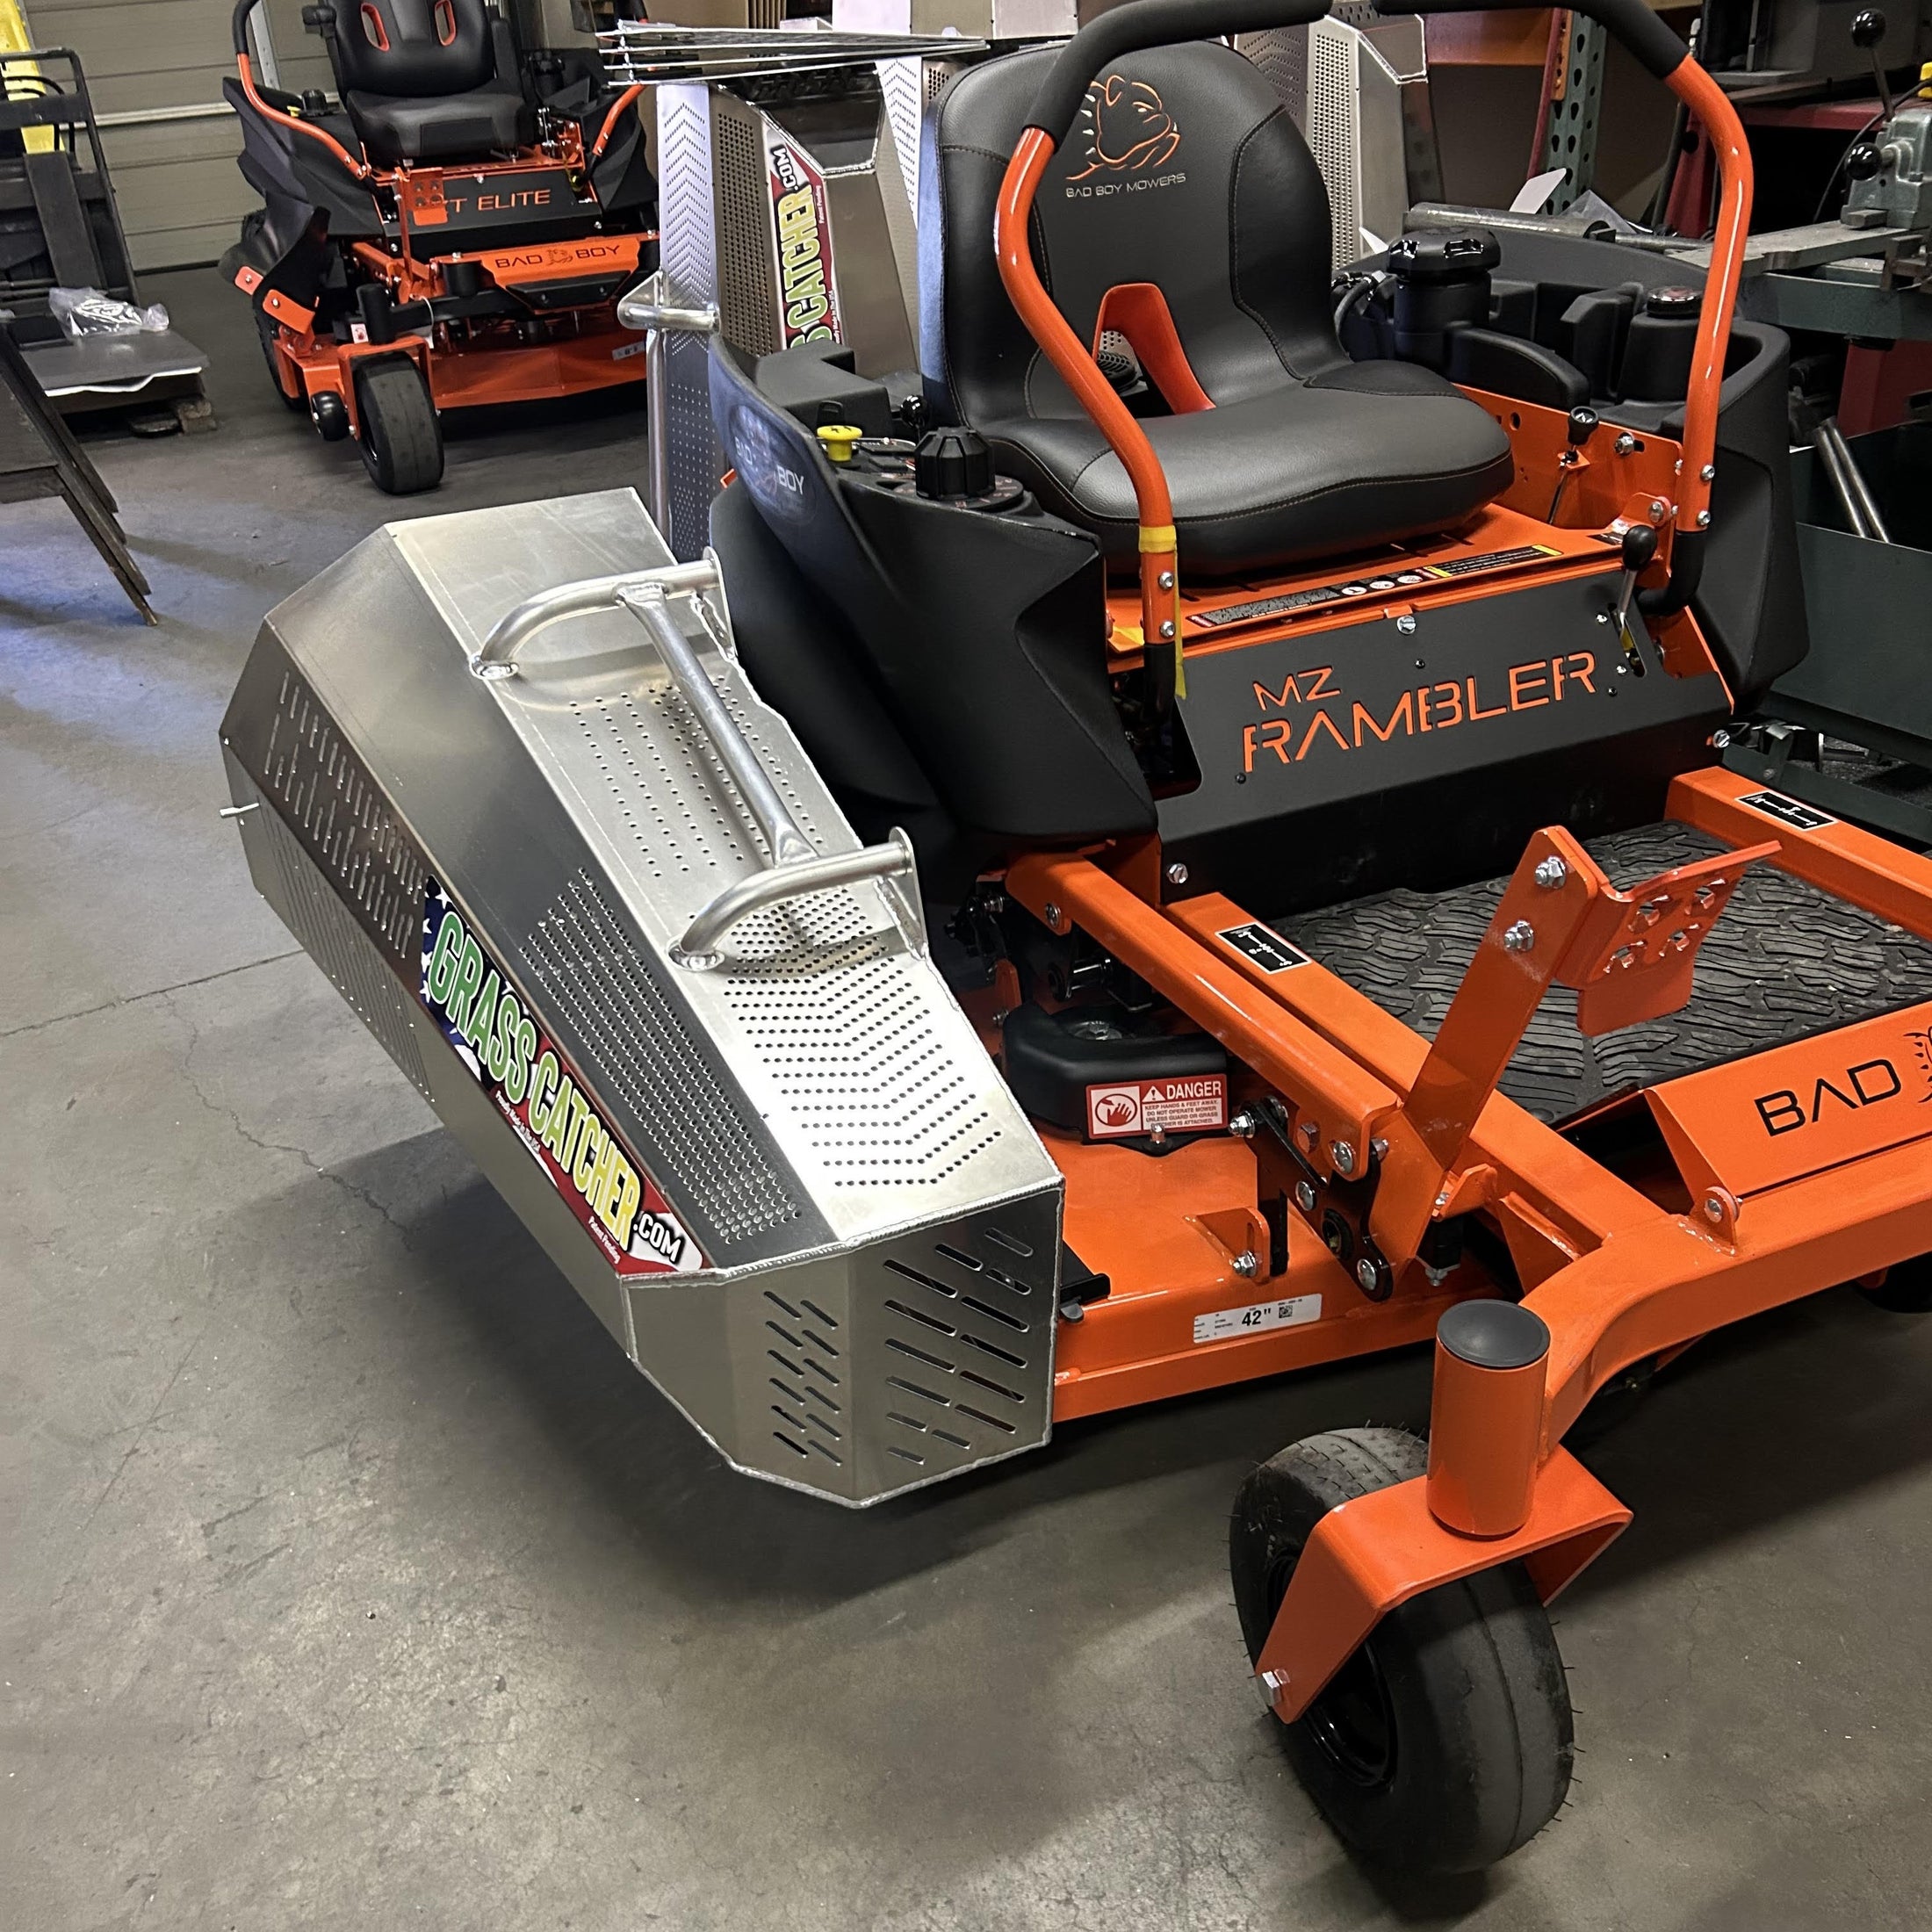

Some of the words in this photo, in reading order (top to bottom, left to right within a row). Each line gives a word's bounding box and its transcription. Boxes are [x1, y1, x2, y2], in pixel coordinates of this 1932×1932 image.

[1066, 187, 1092, 198] BAD
[1096, 184, 1122, 196] BOY
[1127, 173, 1186, 192] MOWERS
[477, 189, 551, 211] ELITE
[494, 254, 543, 268] BAD
[575, 245, 620, 258] BOY
[776, 464, 804, 495] BOY
[1252, 665, 1342, 710] MZ
[1243, 649, 1597, 773] RAMBLER
[428, 911, 537, 1105] GRASS
[1166, 1081, 1222, 1099] DANGER
[1755, 1059, 1901, 1136] BAD
[1241, 1308, 1272, 1327] 42"
